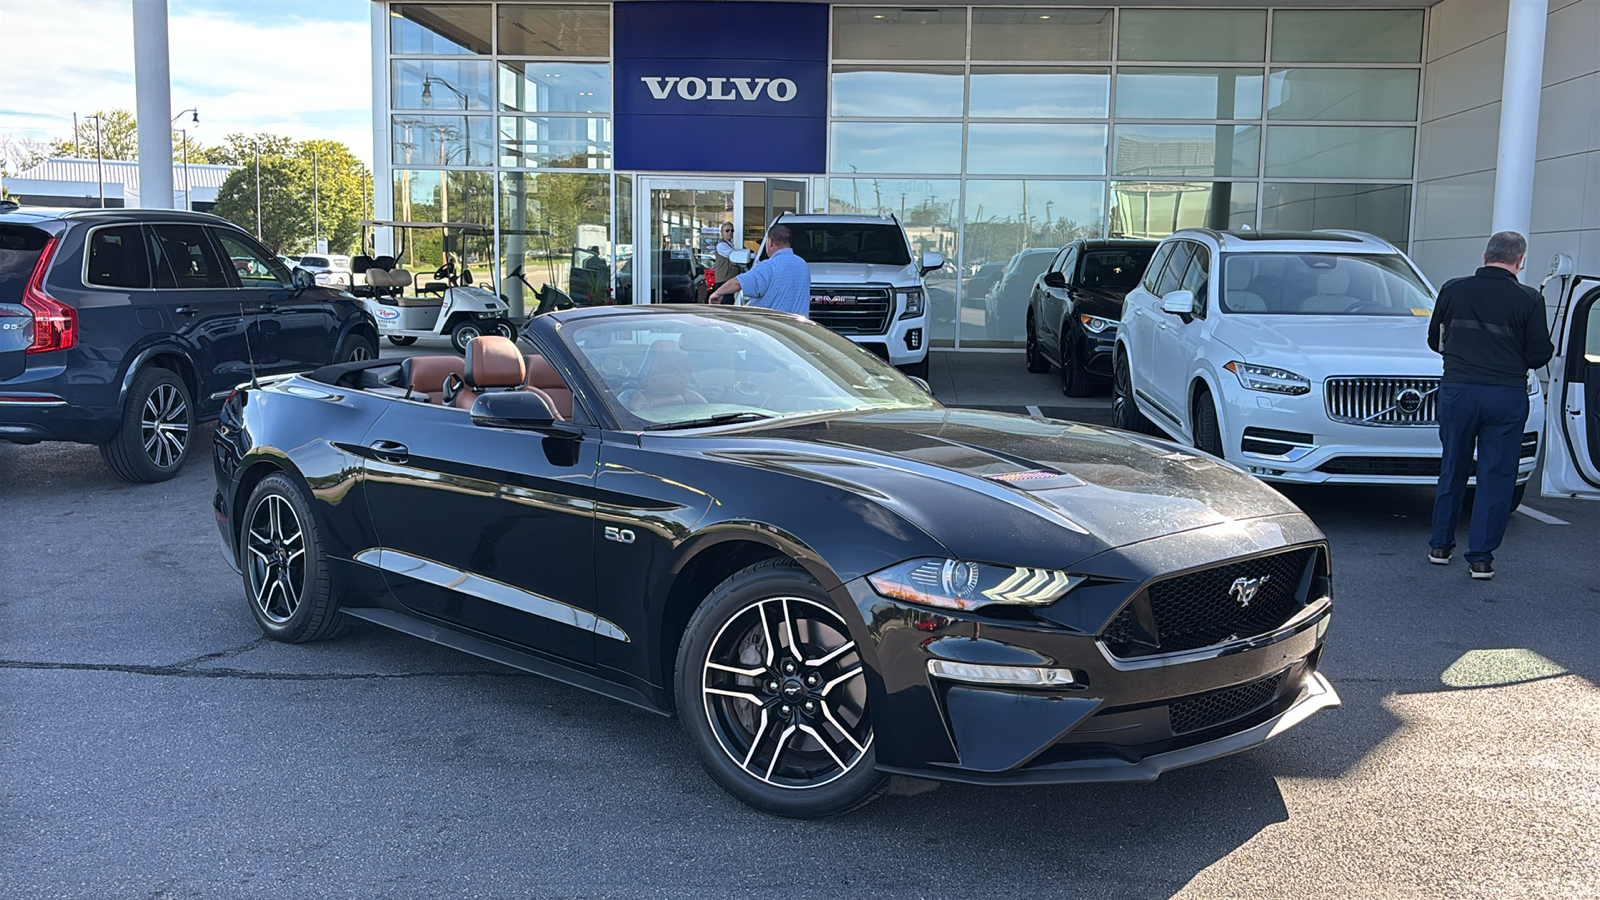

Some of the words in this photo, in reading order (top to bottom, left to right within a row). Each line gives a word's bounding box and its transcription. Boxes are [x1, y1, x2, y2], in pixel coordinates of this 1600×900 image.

[640, 76, 798, 102] VOLVO
[809, 295, 856, 305] GMC
[604, 526, 636, 544] 5.0
